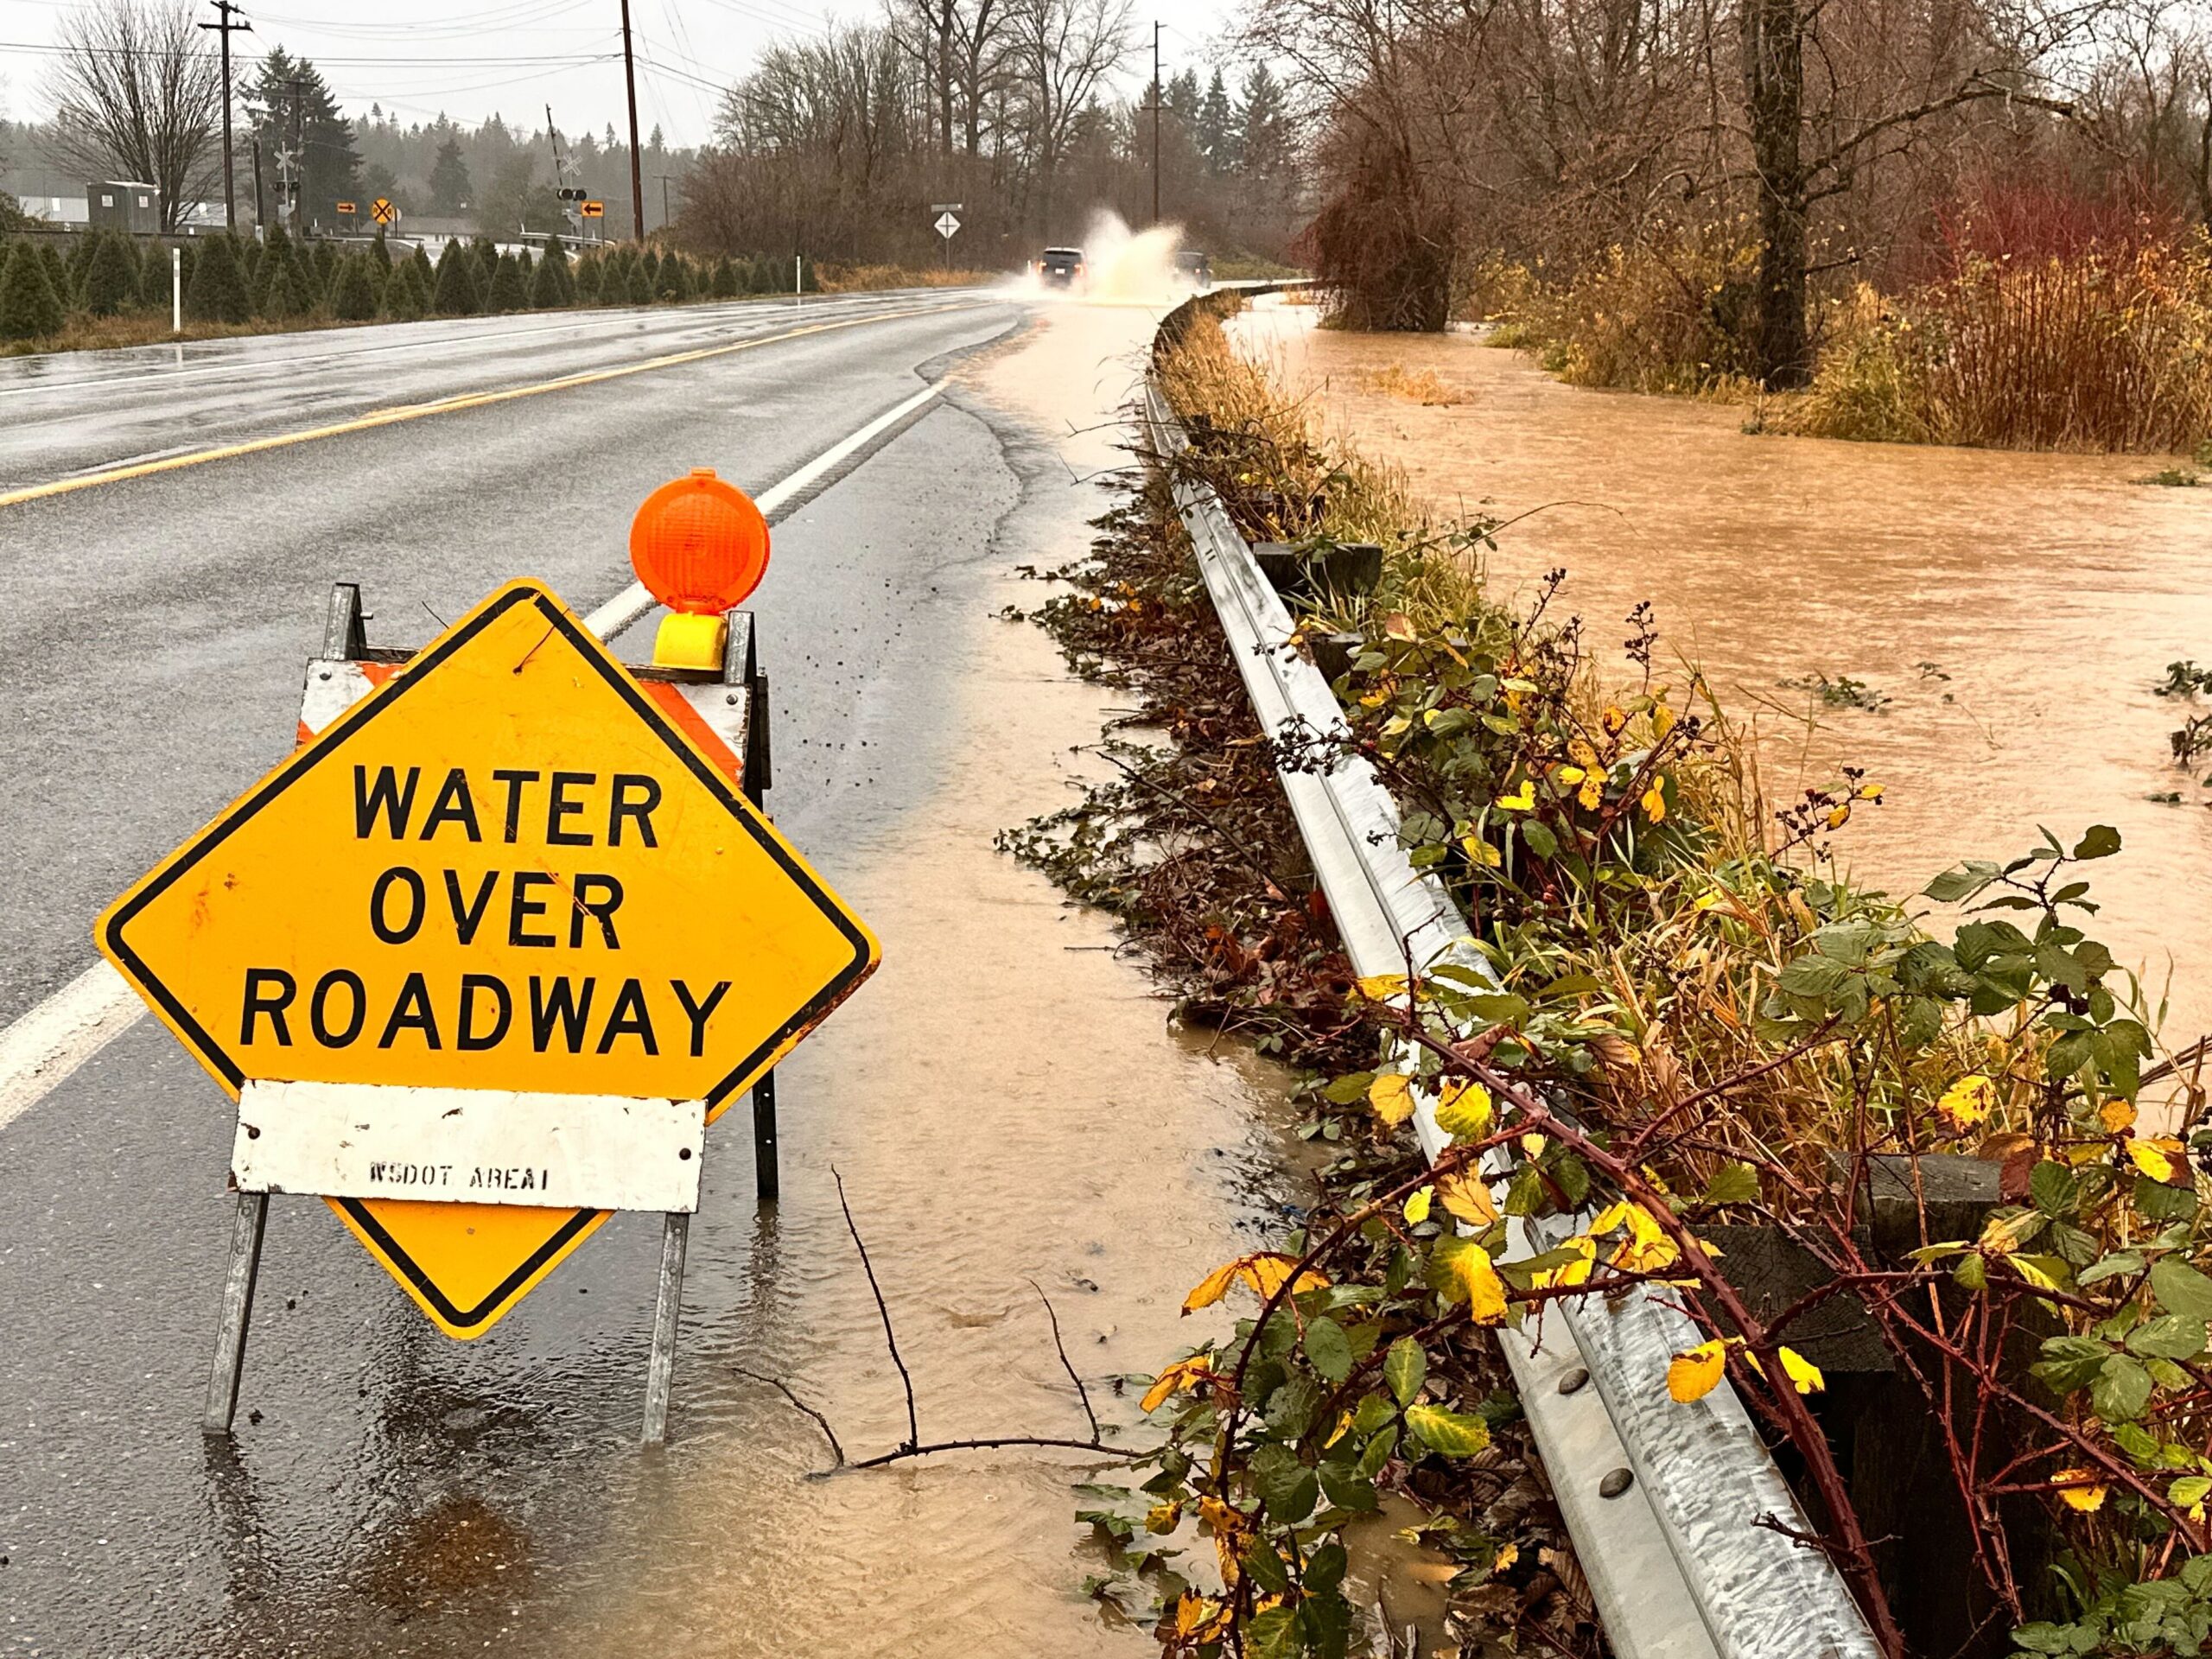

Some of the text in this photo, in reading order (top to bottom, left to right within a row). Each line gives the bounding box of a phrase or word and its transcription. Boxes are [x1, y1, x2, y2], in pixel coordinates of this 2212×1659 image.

[353, 765, 662, 848] WATER
[370, 866, 624, 950] OVER
[240, 968, 733, 1057] ROADWAY
[370, 1161, 453, 1185] WSDOT
